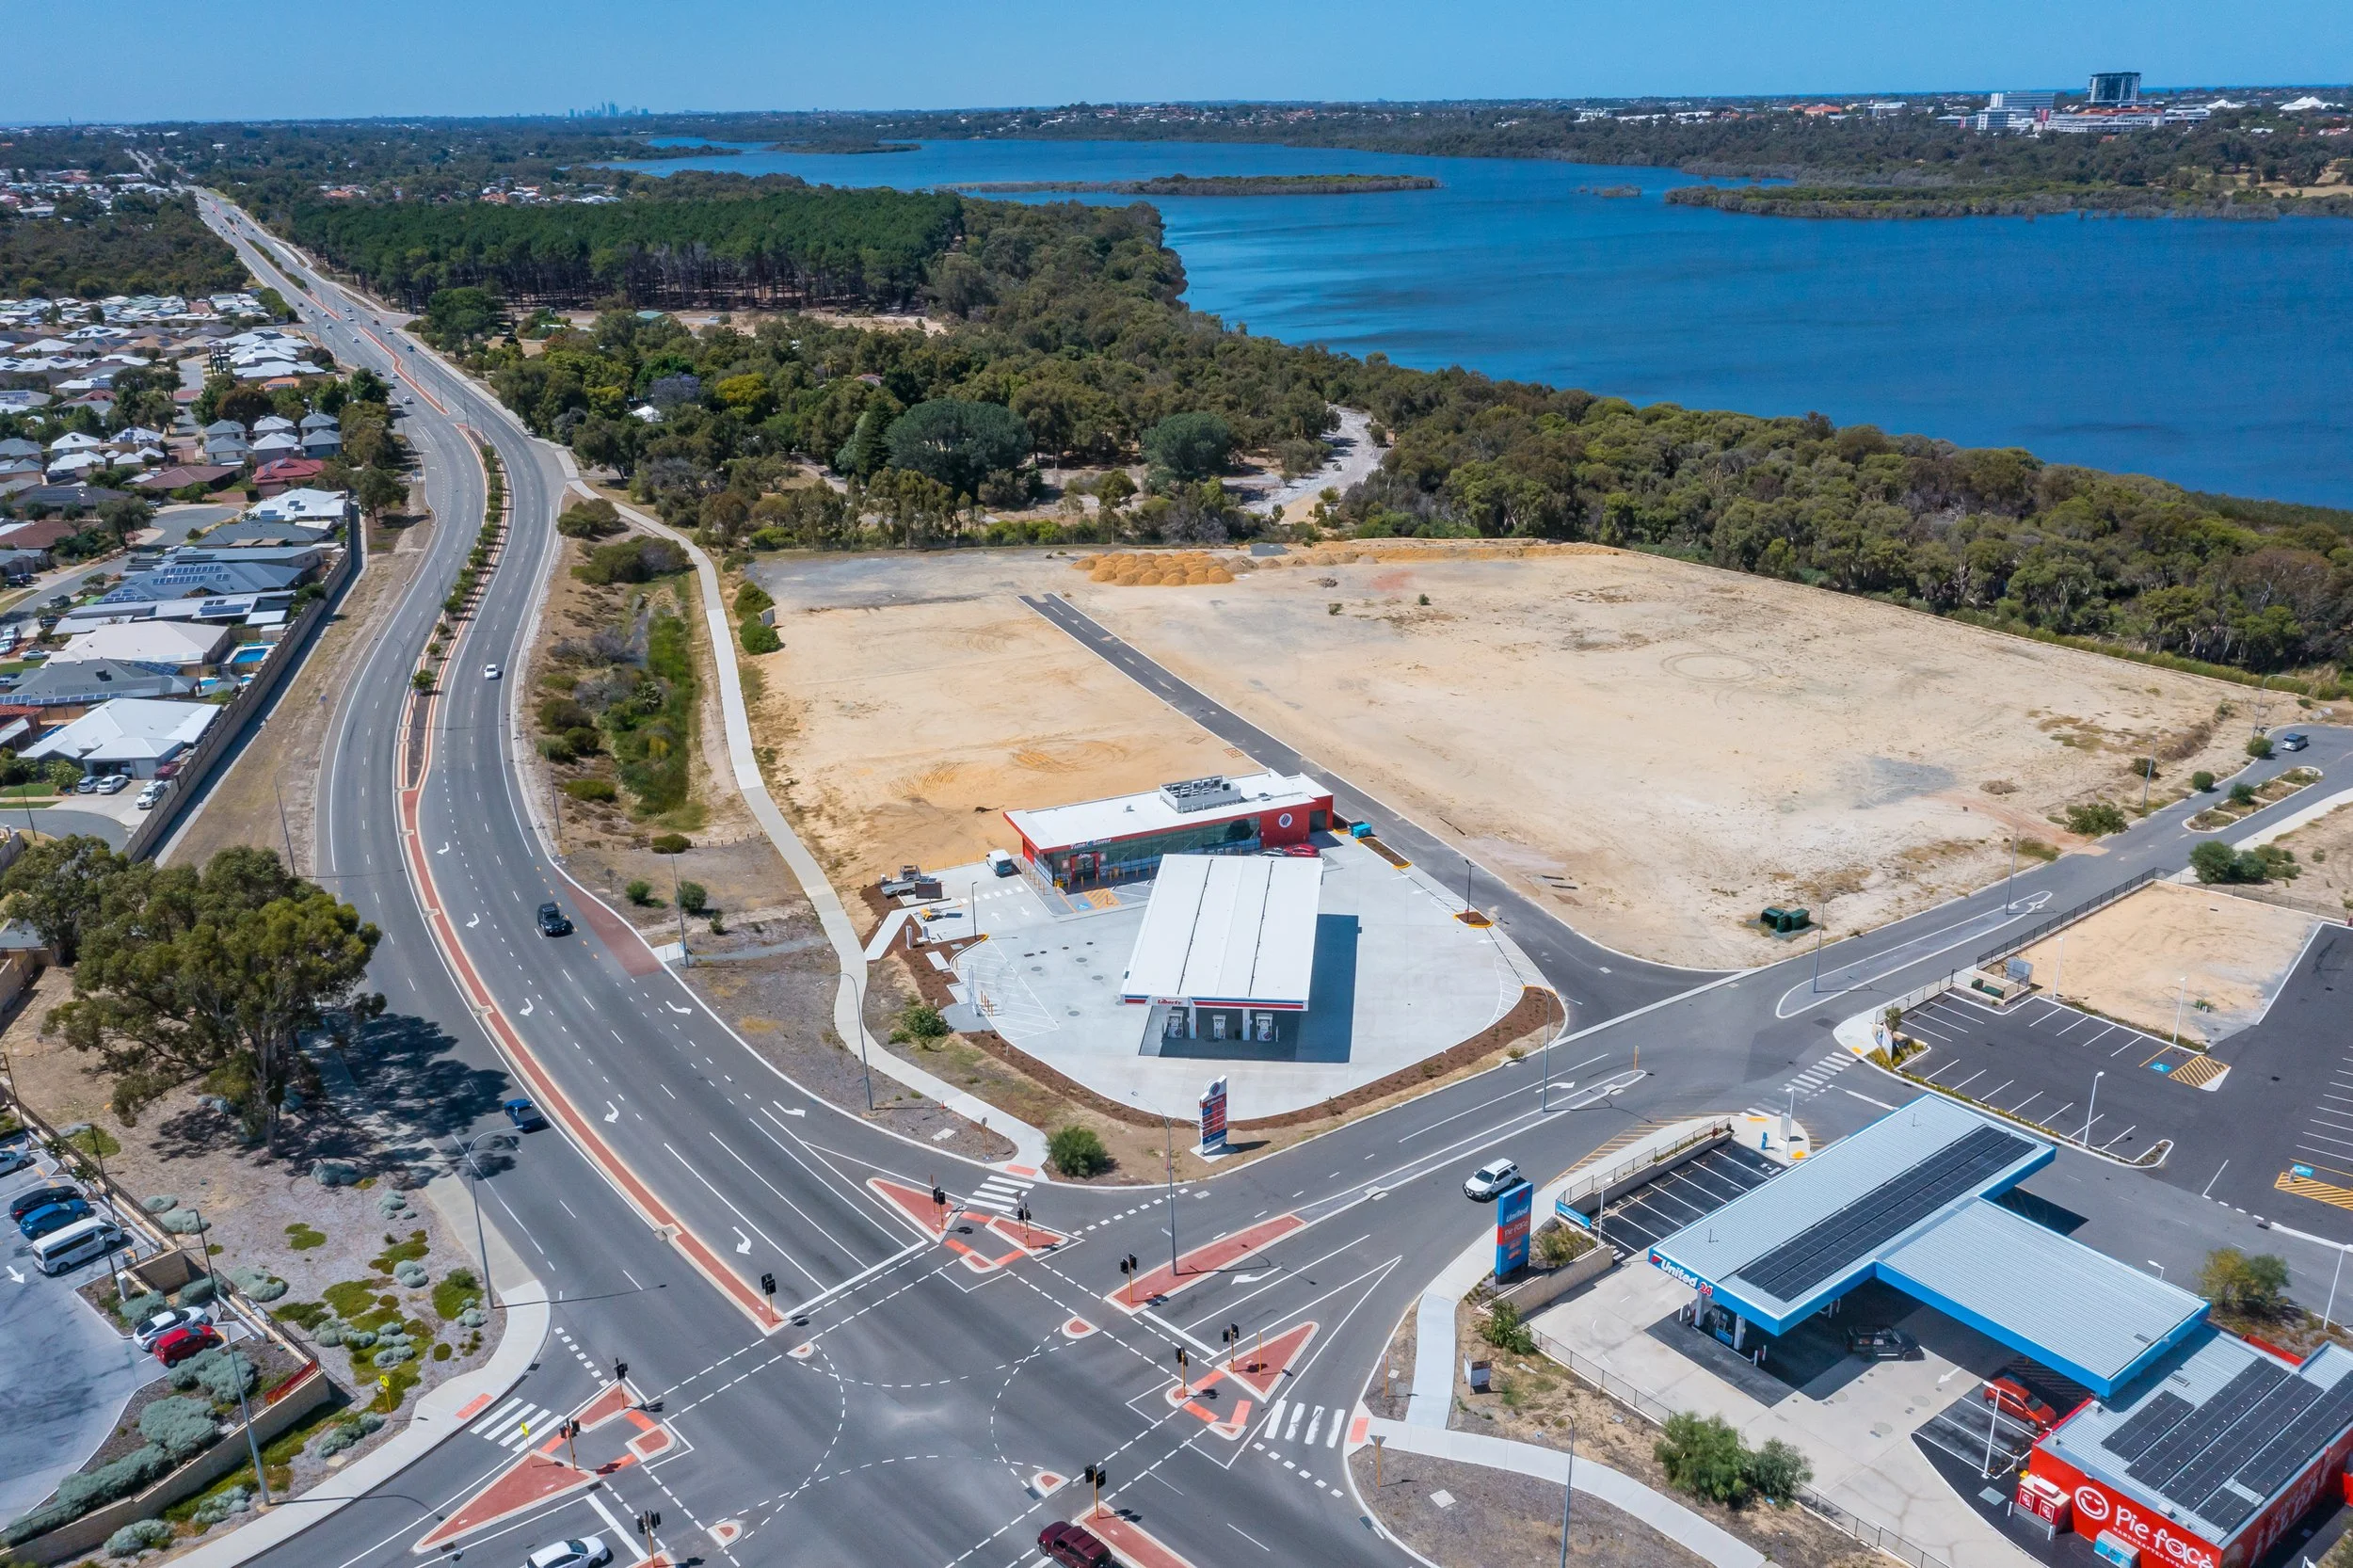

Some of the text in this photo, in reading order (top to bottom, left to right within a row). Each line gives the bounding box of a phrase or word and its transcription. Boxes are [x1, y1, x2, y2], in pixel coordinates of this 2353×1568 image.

[1506, 1206, 1529, 1223] United
[1661, 1259, 1713, 1296] United 24
[2115, 1505, 2150, 1540] Pie
[2112, 1527, 2165, 1559] HANDCRAFTED
